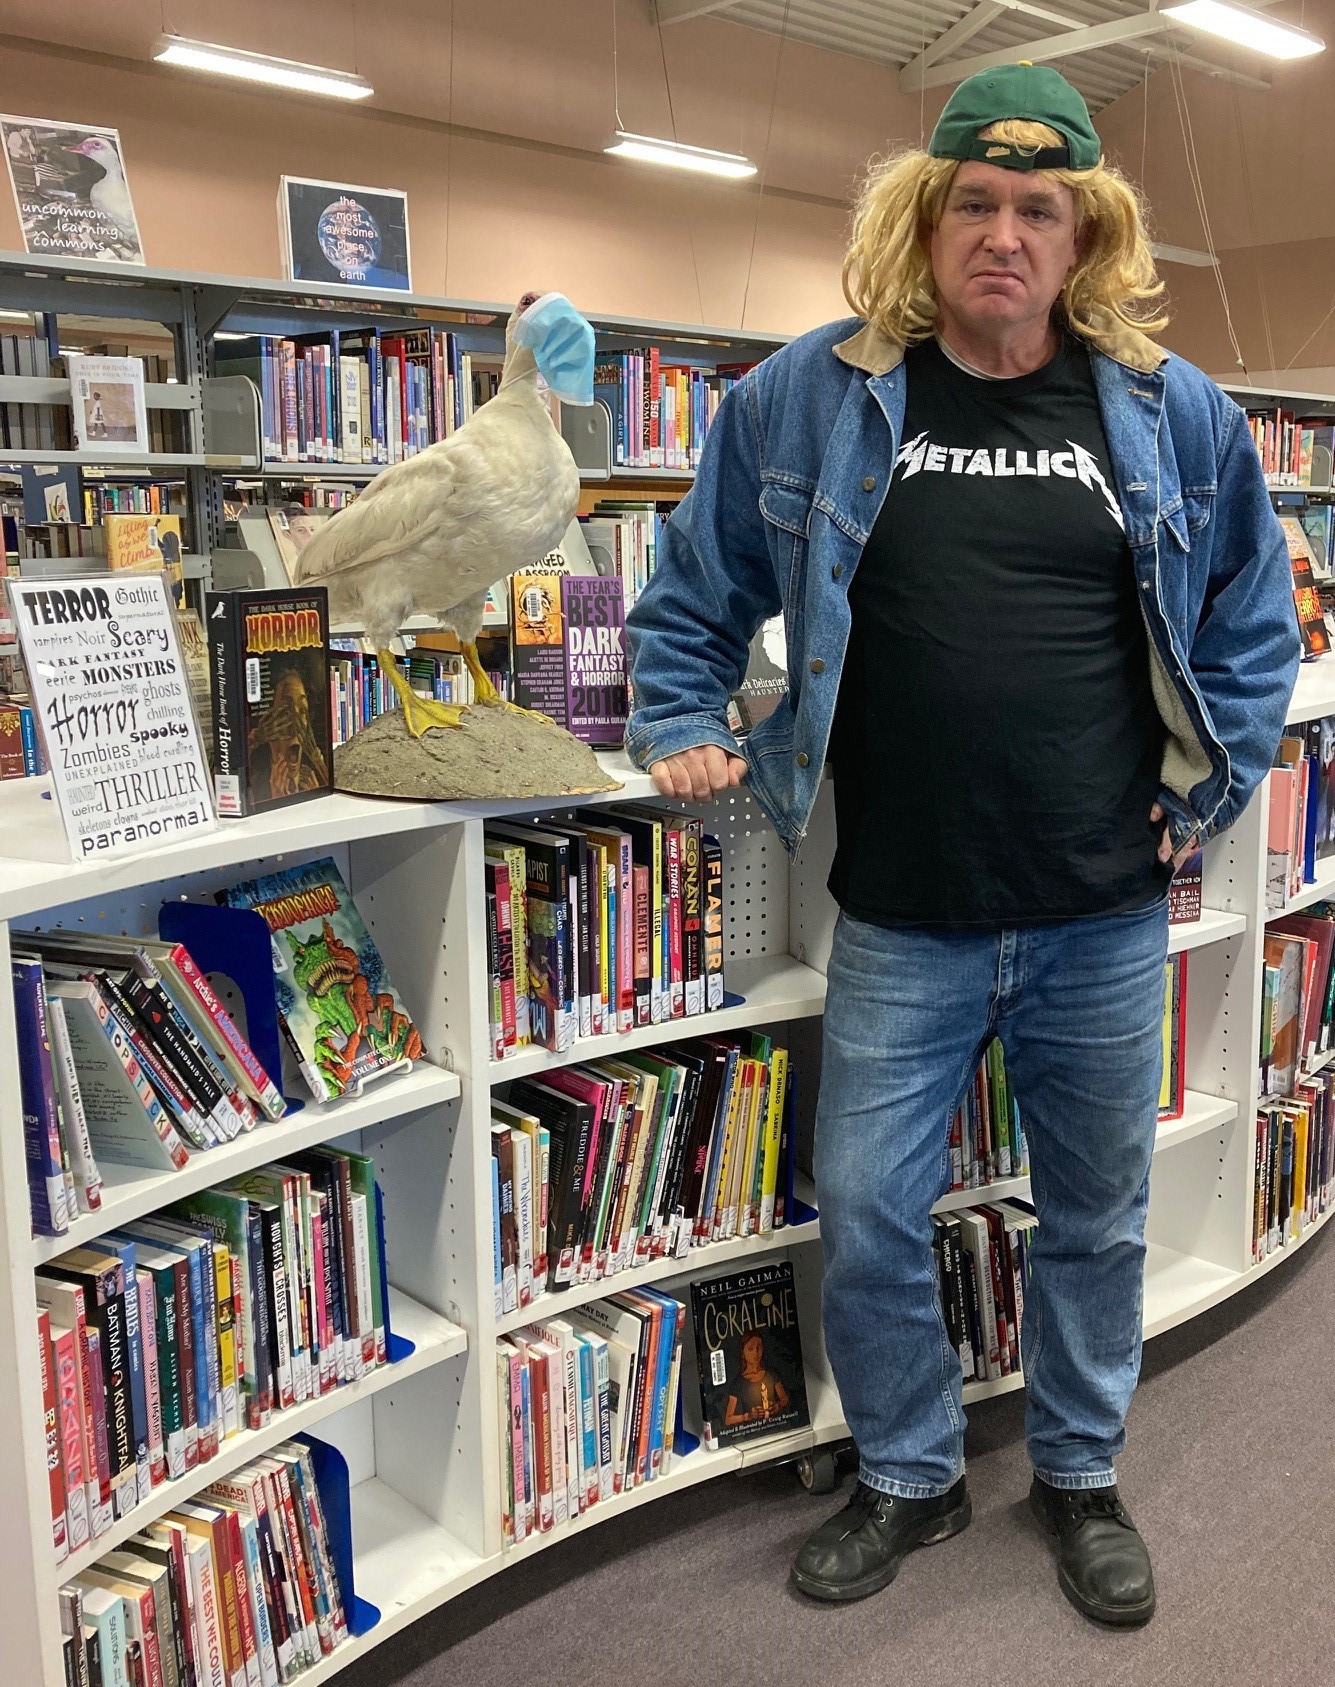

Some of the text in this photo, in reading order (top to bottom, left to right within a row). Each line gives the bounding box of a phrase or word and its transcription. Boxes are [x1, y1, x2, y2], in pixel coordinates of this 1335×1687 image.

[22, 204, 107, 219] uncommon
[340, 196, 355, 207] the
[56, 219, 118, 239] learning
[326, 225, 374, 238] awesome
[337, 212, 362, 222] most
[34, 236, 105, 250] commons
[338, 240, 364, 254] place
[340, 270, 365, 281] earth
[346, 256, 358, 265] on
[650, 400, 658, 418] 150
[894, 431, 1126, 535] METALLICA
[566, 580, 620, 595] THE YEAR'S
[22, 587, 159, 626] TERROR Gothic
[567, 595, 622, 628] BEST
[33, 621, 169, 652] vampires Noir Scary
[246, 610, 323, 654] HORROR
[569, 627, 624, 654] DARK
[85, 649, 145, 663] FANTASY
[217, 656, 225, 675] Dark
[570, 655, 624, 672] FANTASY
[46, 659, 176, 687] eerie MONSTERS
[571, 672, 625, 686] & HORROR
[69, 690, 102, 703] psychos
[143, 681, 181, 706] ghosts
[572, 686, 627, 716] 2018
[750, 686, 790, 696] HAUNTED
[48, 693, 185, 745] Horror chilling
[130, 721, 189, 745] spooky
[572, 717, 587, 725] EDITED
[595, 717, 610, 725] PAULA
[60, 743, 130, 769] Zombies
[218, 727, 231, 775] Horror
[65, 759, 138, 781] UNEXPLAINED
[94, 762, 203, 813] THRILLER
[72, 803, 103, 816] weird
[81, 802, 208, 856] paranormal
[527, 862, 549, 884] APIST
[669, 837, 679, 899] WAR STORIES
[686, 837, 698, 915] CONAN
[500, 900, 511, 930] JOHNNY
[636, 893, 648, 954] CLEMENTE
[690, 921, 695, 929] 4
[707, 861, 722, 969] FLAMER
[191, 976, 266, 1081] Archie's AMERICANA
[112, 1004, 135, 1034] ARCHIE
[135, 1039, 163, 1071] CROSSOVER
[157, 1068, 185, 1101] COLLECTION
[161, 1026, 216, 1098] THE HANDMAID'S TALE
[98, 1007, 168, 1129] CHOPSTICK
[351, 1063, 379, 1077] VOLUME
[152, 1075, 173, 1101] ROMANCE
[772, 1113, 780, 1141] SABRINA
[572, 1120, 589, 1193] FREDDIE & ME
[622, 1161, 634, 1186] PYONGYANG
[499, 1183, 510, 1214] DAHMER
[201, 1214, 226, 1228] SWISS
[521, 1190, 531, 1242] Wrenchies
[271, 1221, 288, 1323] NOUGHTS CROSSES
[701, 1281, 732, 1297] NEIL
[738, 1267, 791, 1287] GAIMAN
[983, 1265, 992, 1304] DESTRUCTION
[122, 1266, 140, 1337] THE BEATLES
[596, 1310, 608, 1321] DAY
[180, 1318, 192, 1350] Mother?
[256, 1292, 267, 1346] NEIGHBORS
[704, 1288, 795, 1351] CORALINE
[107, 1303, 122, 1371] BATMAN
[77, 1329, 91, 1407] GRAPHIC HISTORY
[511, 1362, 520, 1393] EMMA
[150, 1400, 161, 1440] VAGRANT
[600, 1392, 610, 1462] THE GREAT GATSBY
[210, 1490, 248, 1503] AMERICA!
[217, 1483, 247, 1497] DEAD!
[251, 1483, 267, 1515] MARVEL
[231, 1560, 250, 1598] ALGERIA
[197, 1562, 218, 1647] THE BEST WE
[250, 1582, 273, 1642] OPEN BORDERS
[106, 1615, 121, 1664] SOLUTIONS
[146, 1641, 158, 1662] LUCY
